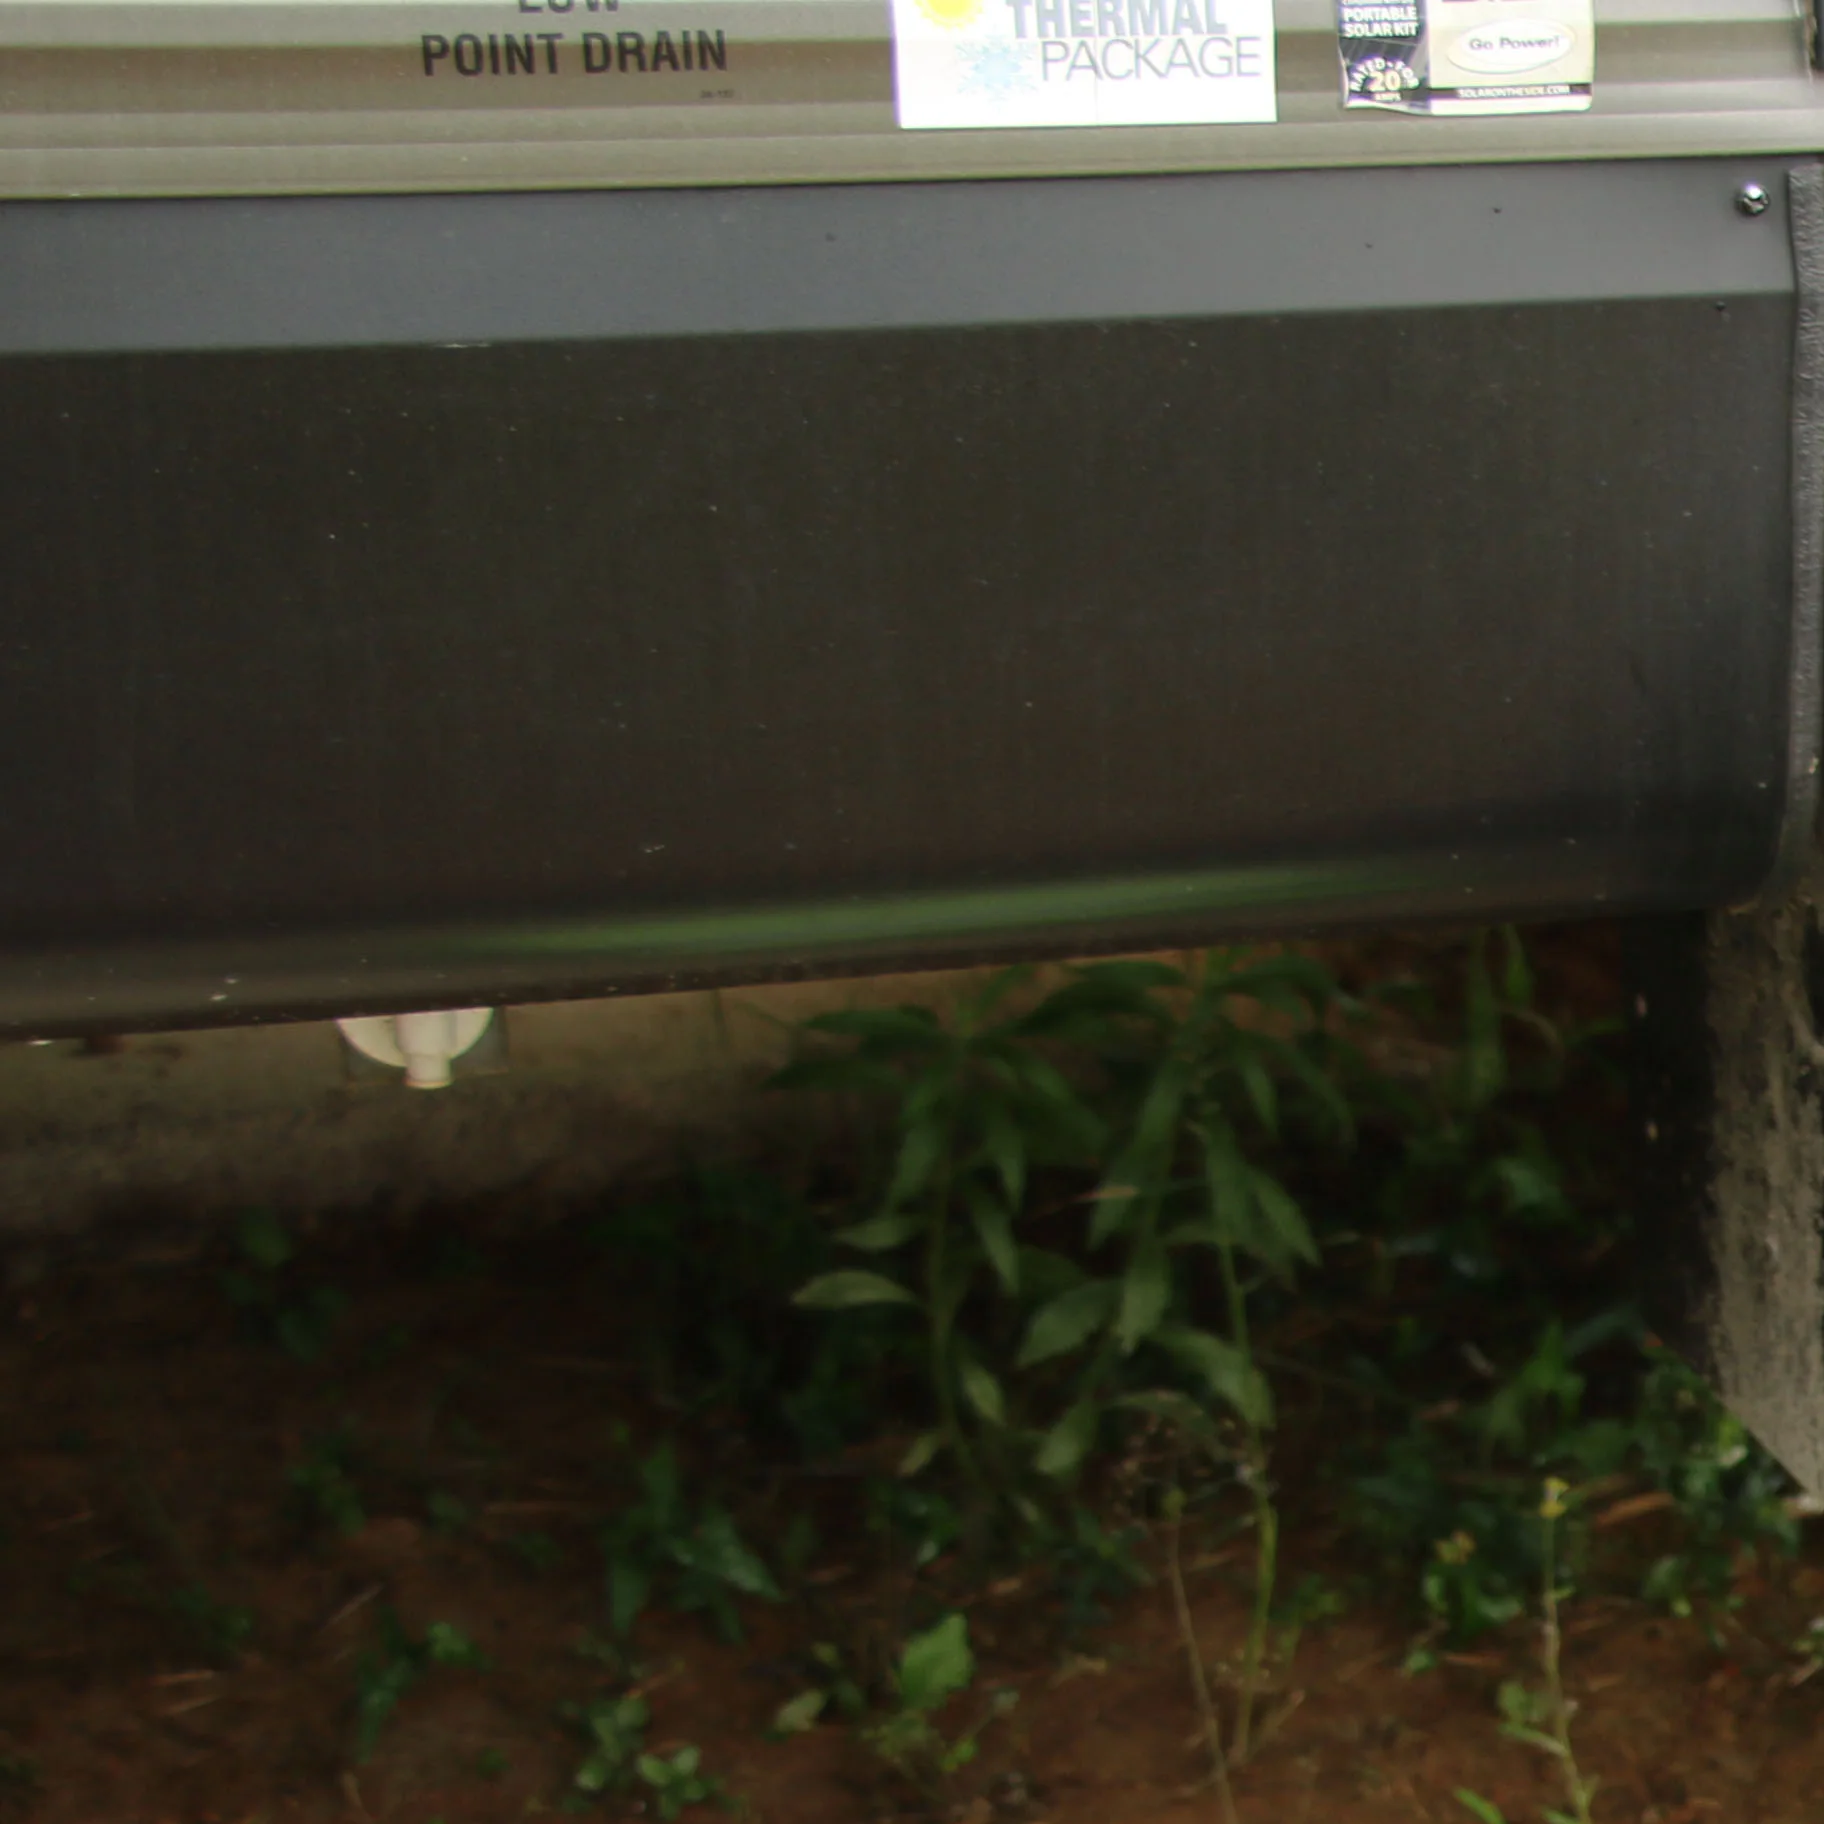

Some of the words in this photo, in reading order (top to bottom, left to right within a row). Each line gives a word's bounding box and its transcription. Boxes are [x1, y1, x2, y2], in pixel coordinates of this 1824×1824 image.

[1006, 0, 1228, 38] THERMAL
[1343, 6, 1417, 21] PORTABLE
[1344, 22, 1393, 37] SOLAR
[1394, 21, 1419, 36] KIT
[421, 33, 564, 76] POINT
[582, 29, 728, 74] DRAIN
[1469, 38, 1493, 50] Go
[1500, 35, 1560, 49] Power!
[1041, 36, 1261, 81] PACKAGE
[1368, 69, 1401, 92] 20
